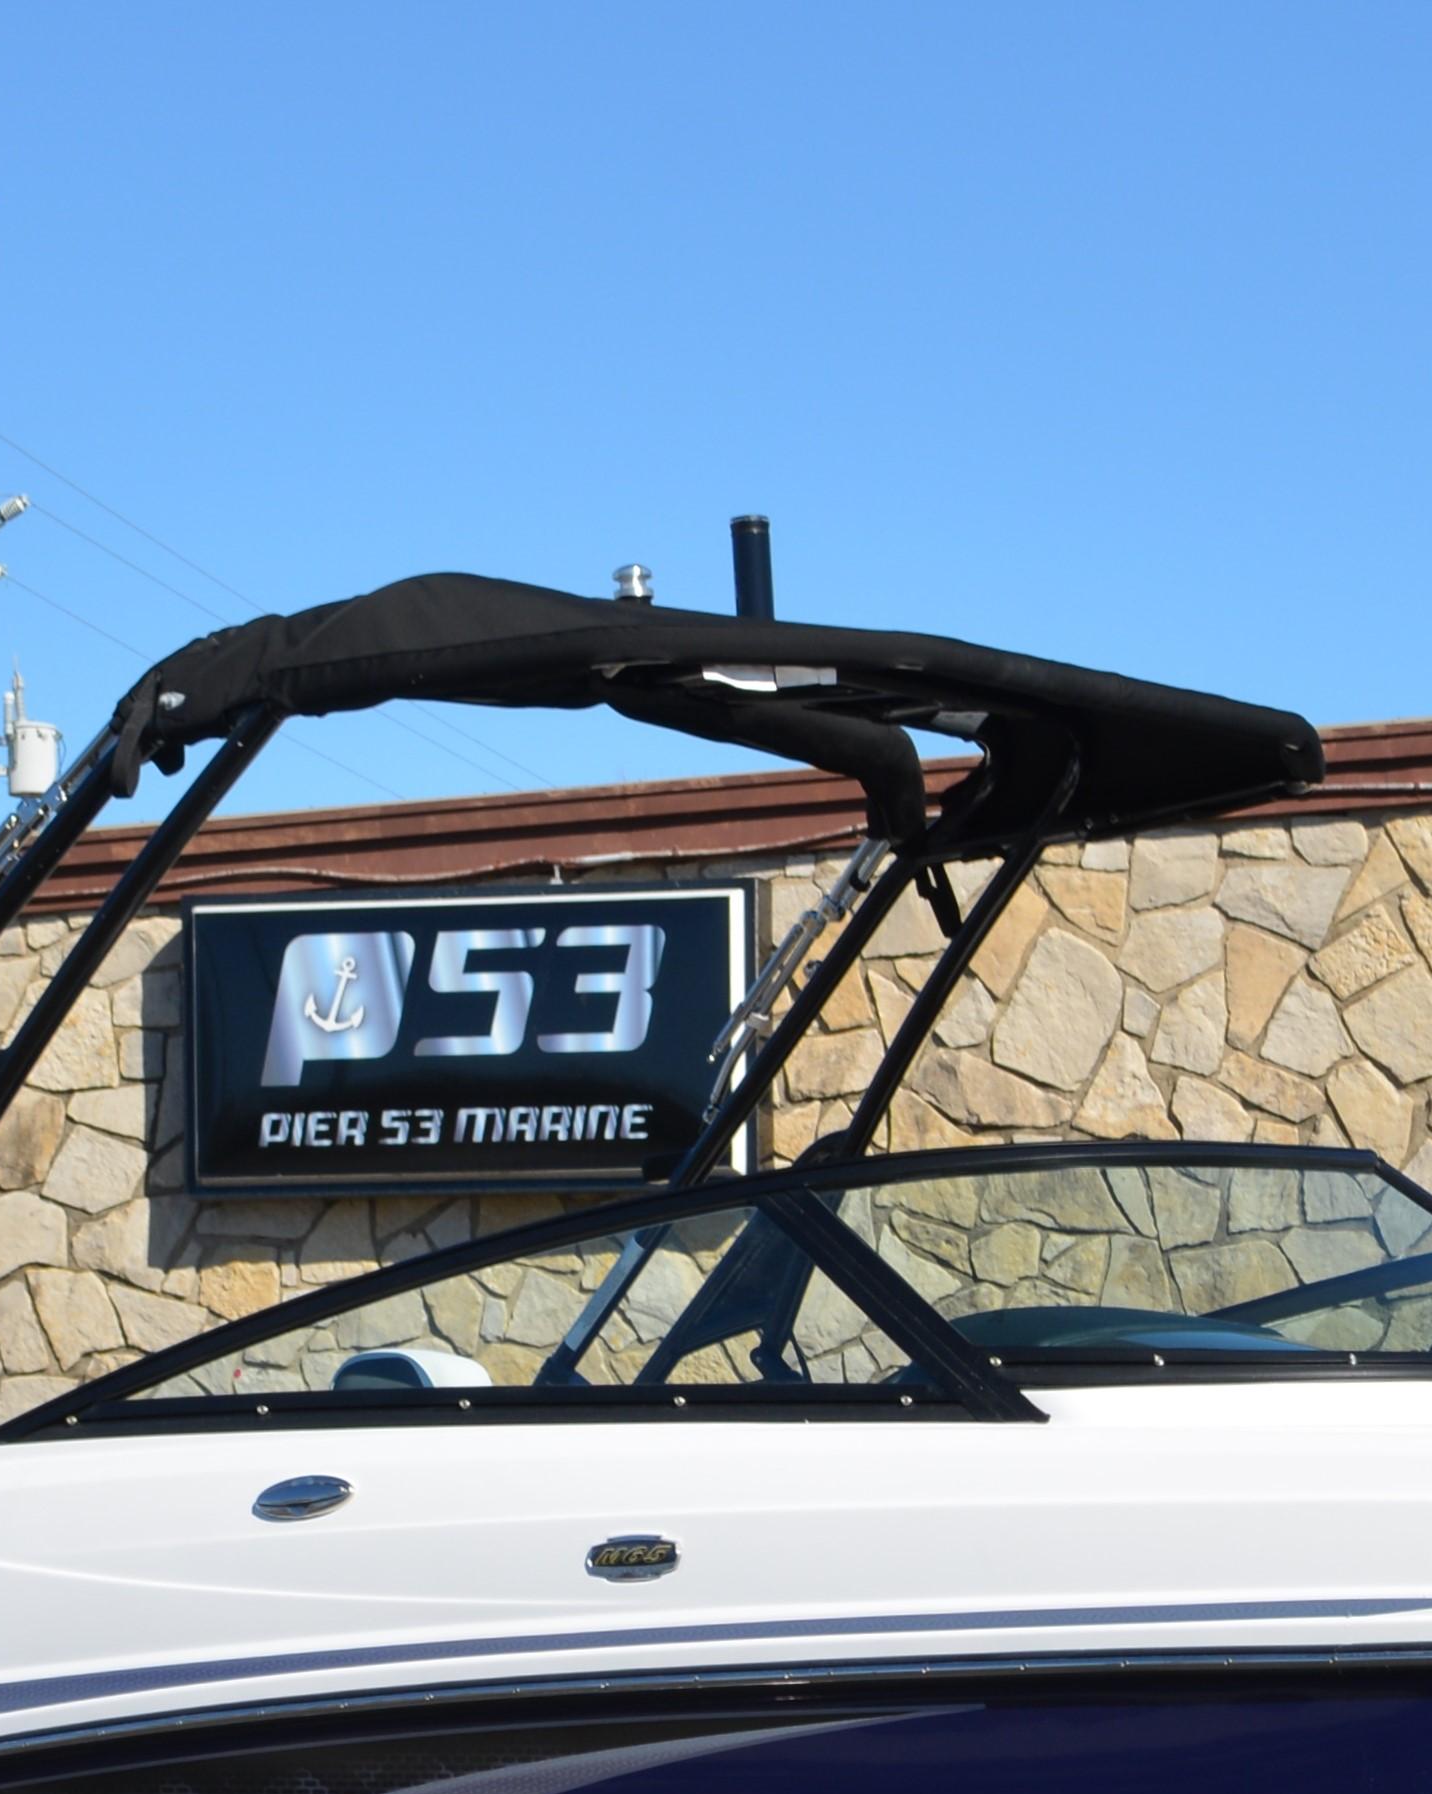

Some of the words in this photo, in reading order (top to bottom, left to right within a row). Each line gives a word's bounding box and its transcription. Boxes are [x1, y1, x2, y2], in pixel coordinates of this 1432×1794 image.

[258, 1110, 369, 1147] PIER
[378, 1108, 445, 1145] 53
[453, 1103, 655, 1144] MARINE
